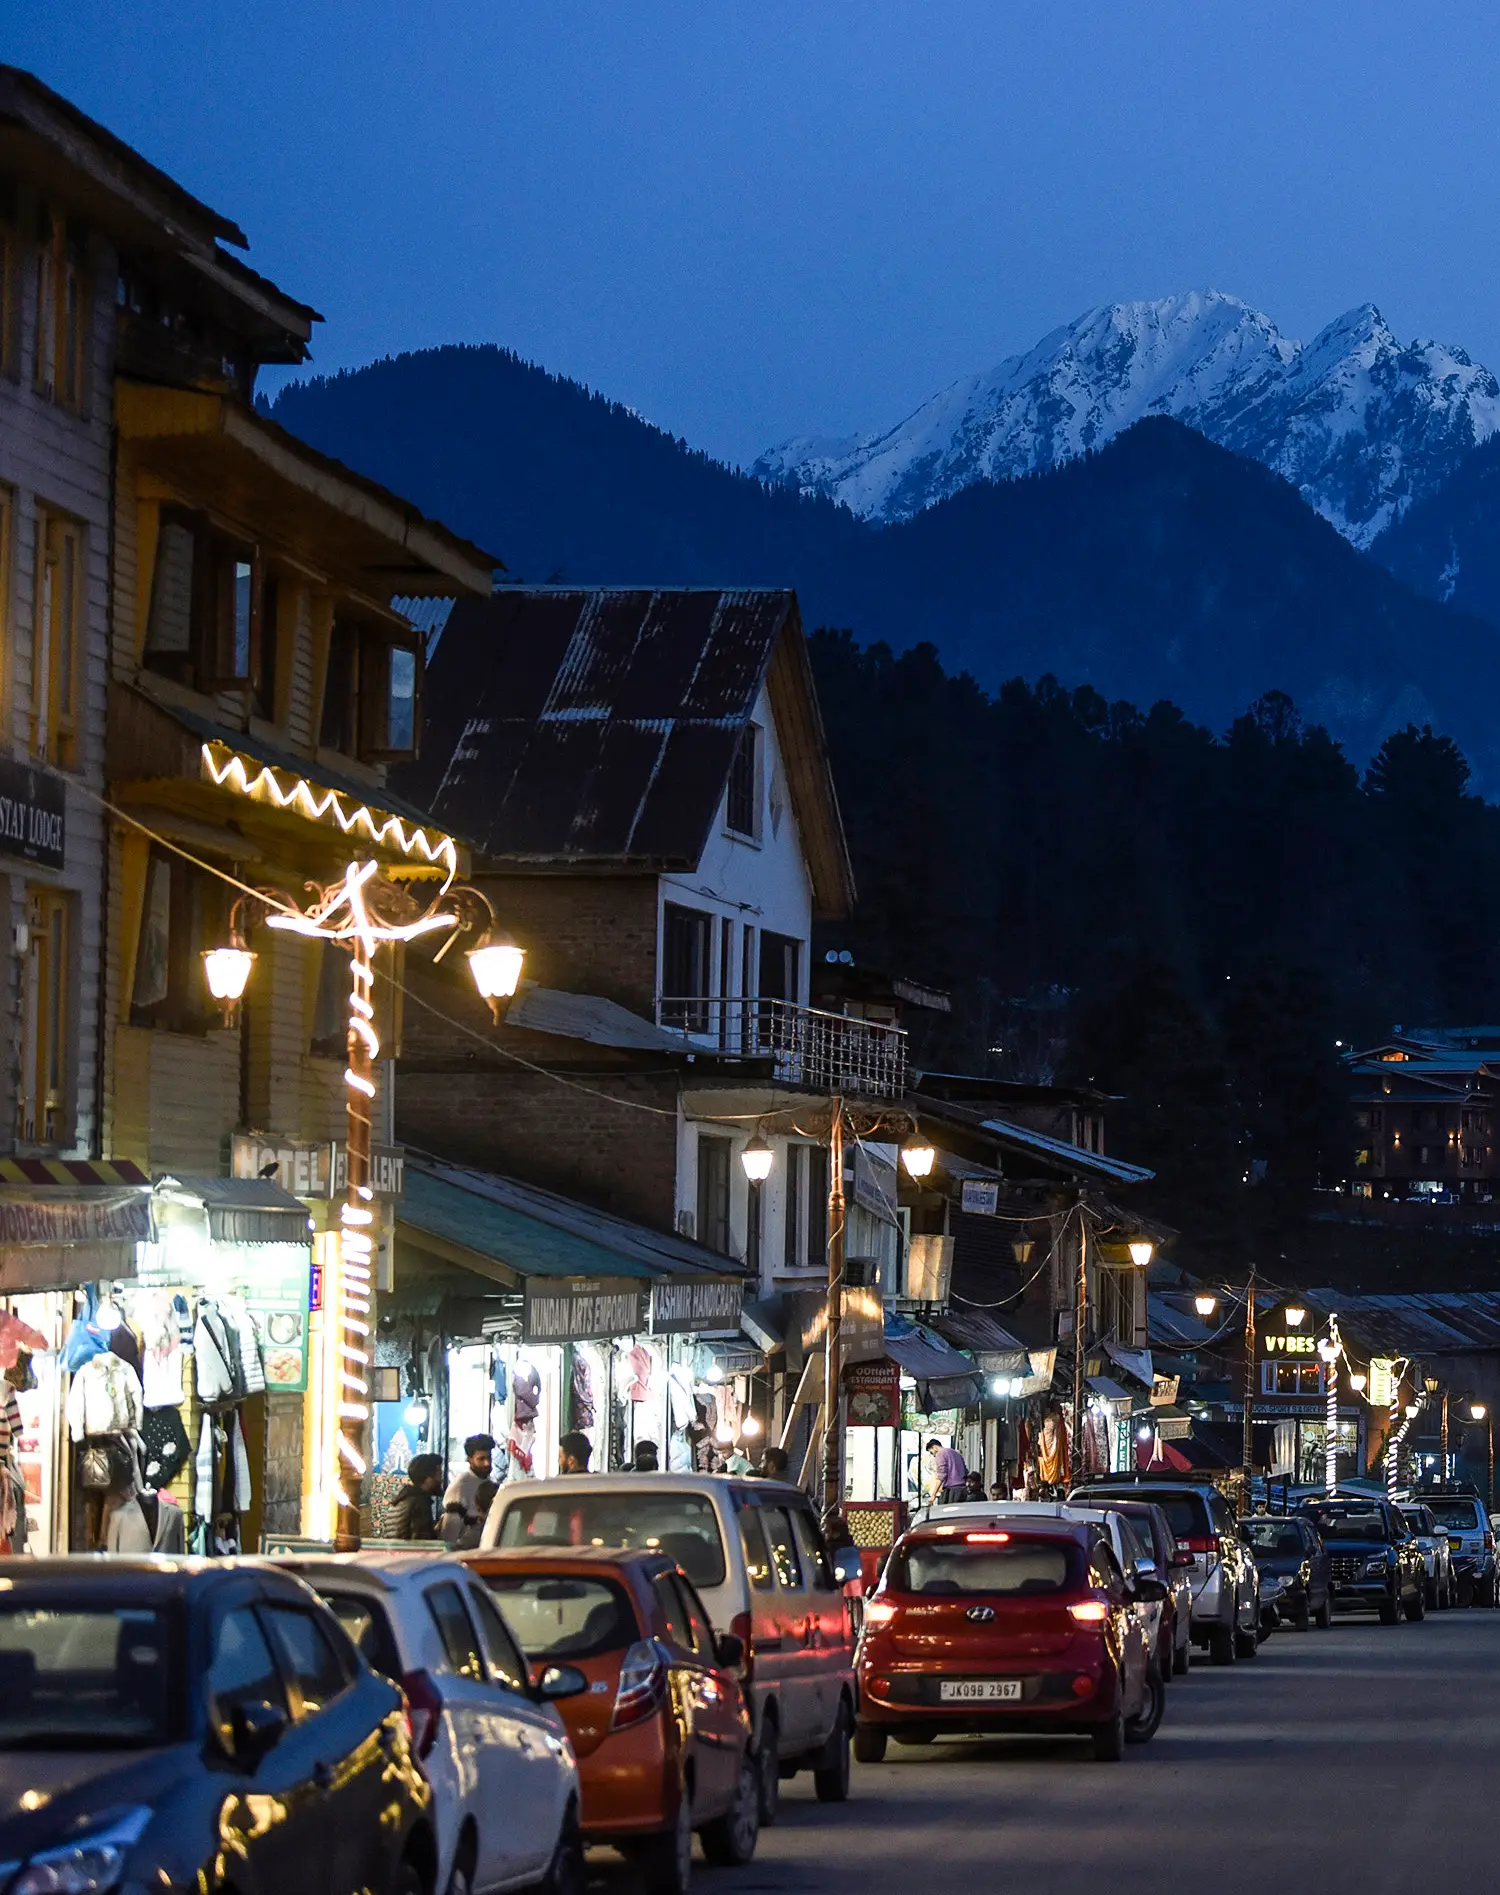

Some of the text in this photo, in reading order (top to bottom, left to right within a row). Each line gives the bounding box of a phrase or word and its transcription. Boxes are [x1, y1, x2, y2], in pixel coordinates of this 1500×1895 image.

[28, 806, 62, 852] LODGE
[239, 1144, 404, 1194] HOTEL ELENT
[93, 1203, 149, 1240] PALAC
[570, 1297, 593, 1335] ARTS
[594, 1292, 638, 1333] EMPORIUM
[653, 1284, 692, 1320] KASHMIR
[1119, 1420, 1128, 1472] SUPER
[989, 1684, 1017, 1697] 2967
